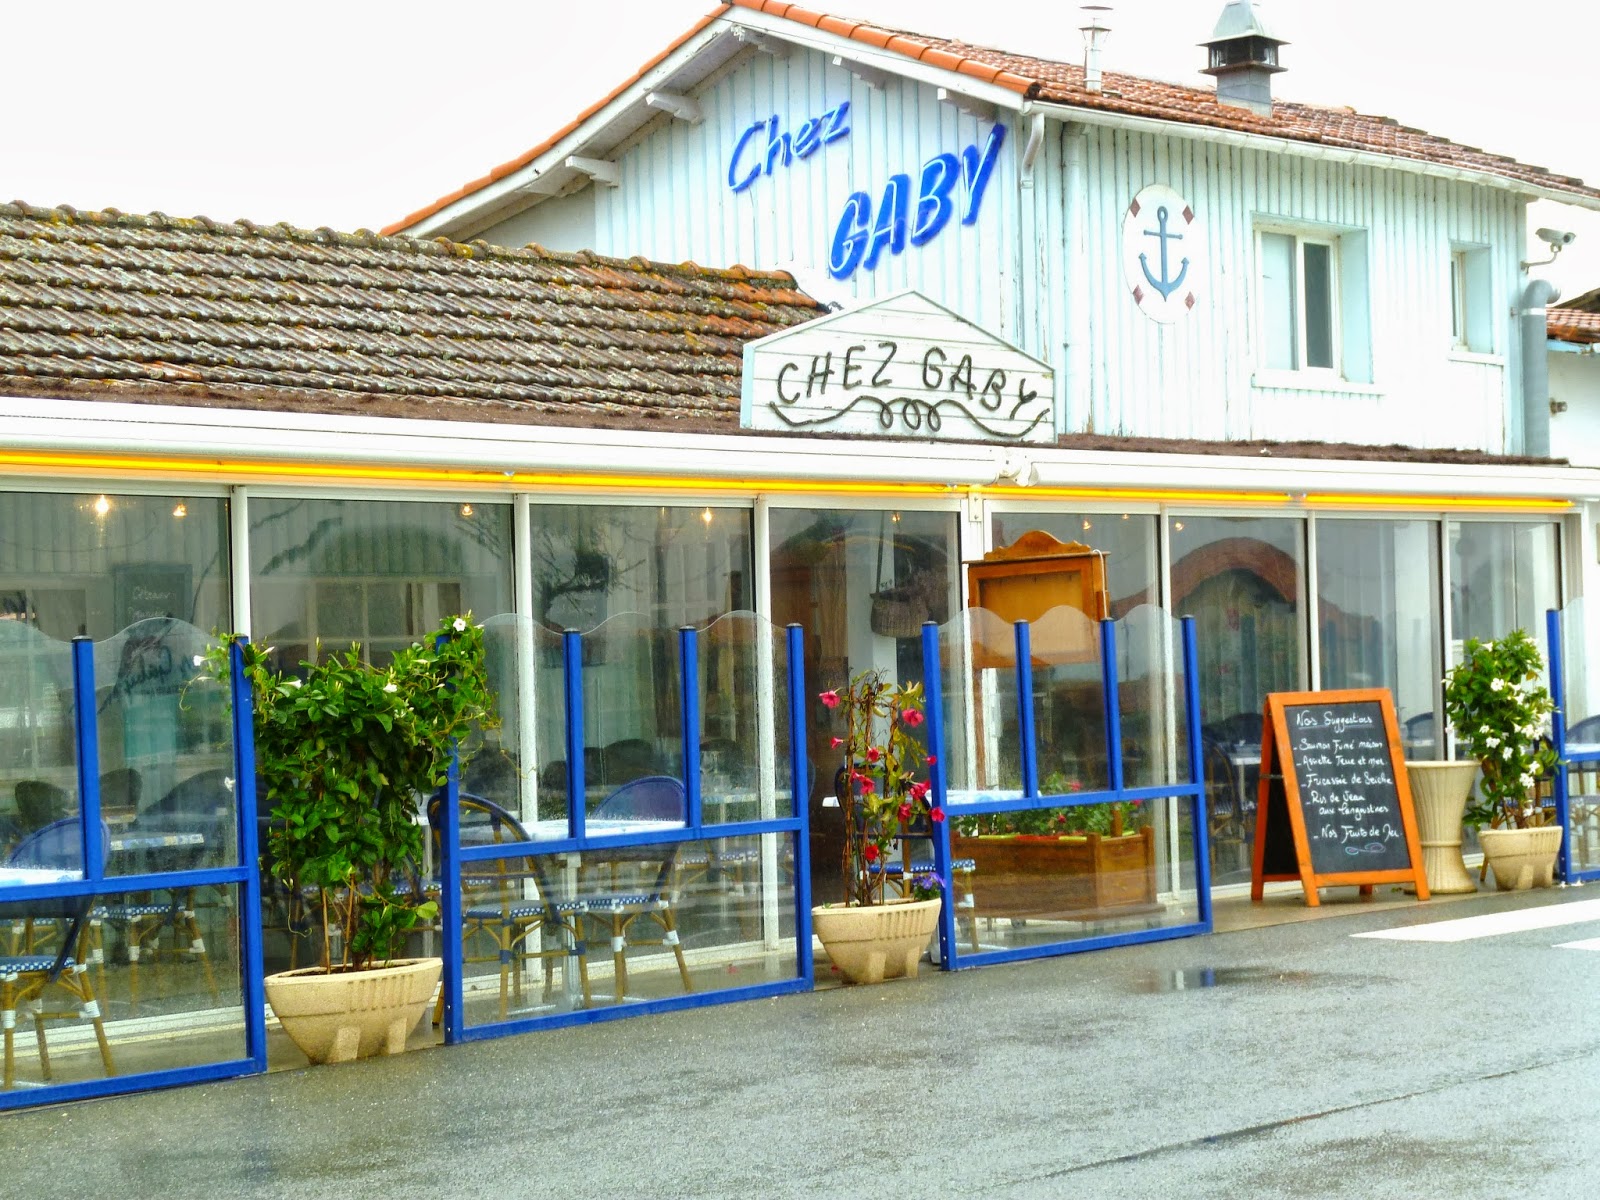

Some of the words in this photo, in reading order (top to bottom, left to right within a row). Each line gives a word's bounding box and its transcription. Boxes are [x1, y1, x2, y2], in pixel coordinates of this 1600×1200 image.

[728, 101, 851, 192] Chez
[828, 122, 1006, 280] GABY
[777, 341, 898, 405] CHEZ
[922, 346, 1038, 420] GABY
[1296, 710, 1318, 727] Nos
[1323, 710, 1373, 733] Suggestions
[1357, 755, 1367, 765] et
[1350, 771, 1362, 785] de
[1310, 790, 1327, 804] Ris
[1329, 791, 1340, 803] de
[1318, 806, 1335, 816] aux
[1321, 824, 1339, 838] Nos
[1368, 825, 1380, 837] de
